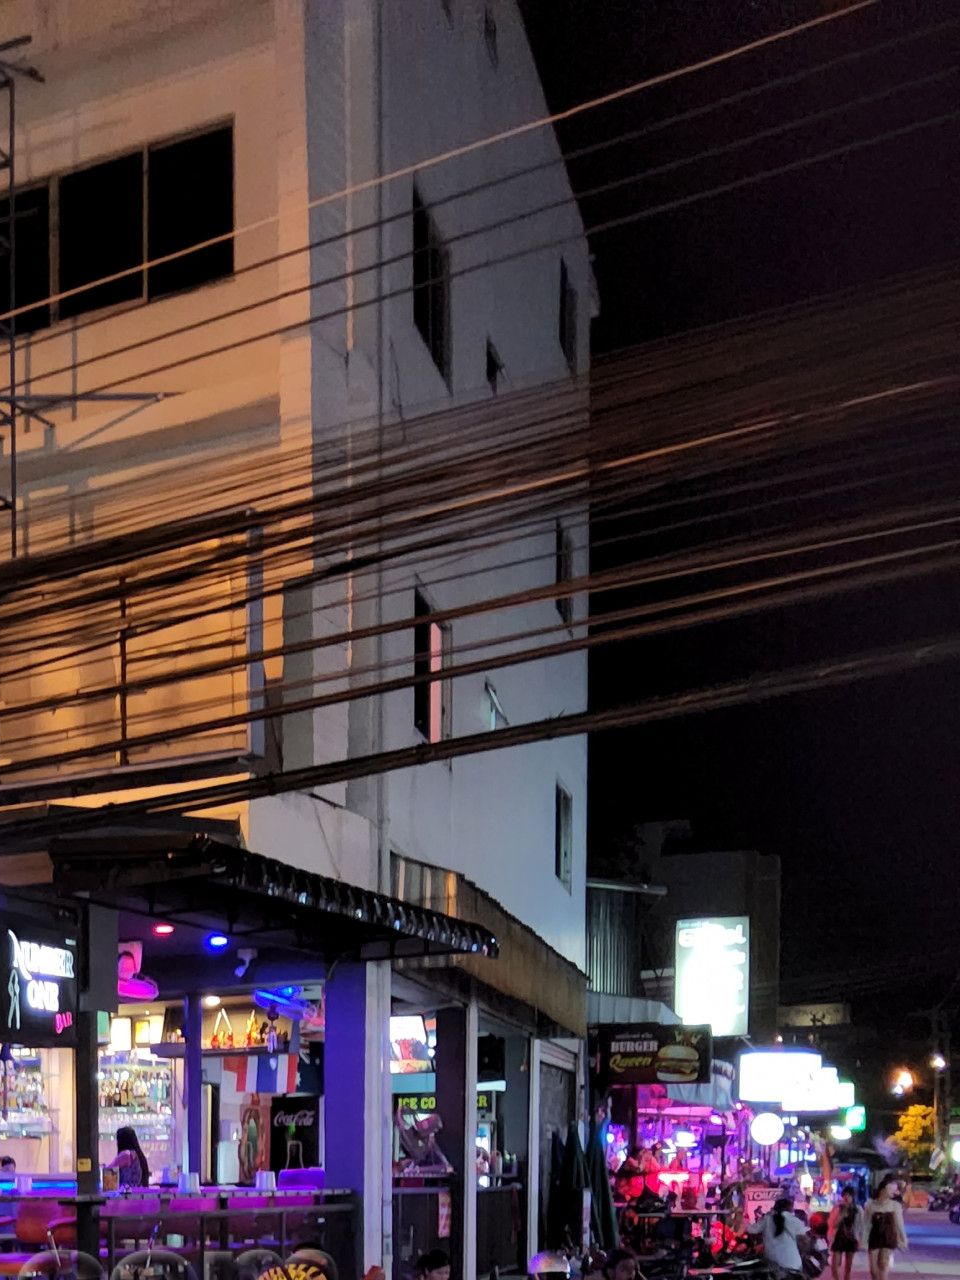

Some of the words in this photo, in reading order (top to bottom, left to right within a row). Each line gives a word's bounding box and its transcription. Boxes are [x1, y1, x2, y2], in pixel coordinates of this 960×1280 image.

[8, 928, 75, 980] NUMBER
[27, 979, 59, 1012] ONE
[610, 1040, 659, 1053] BURGER
